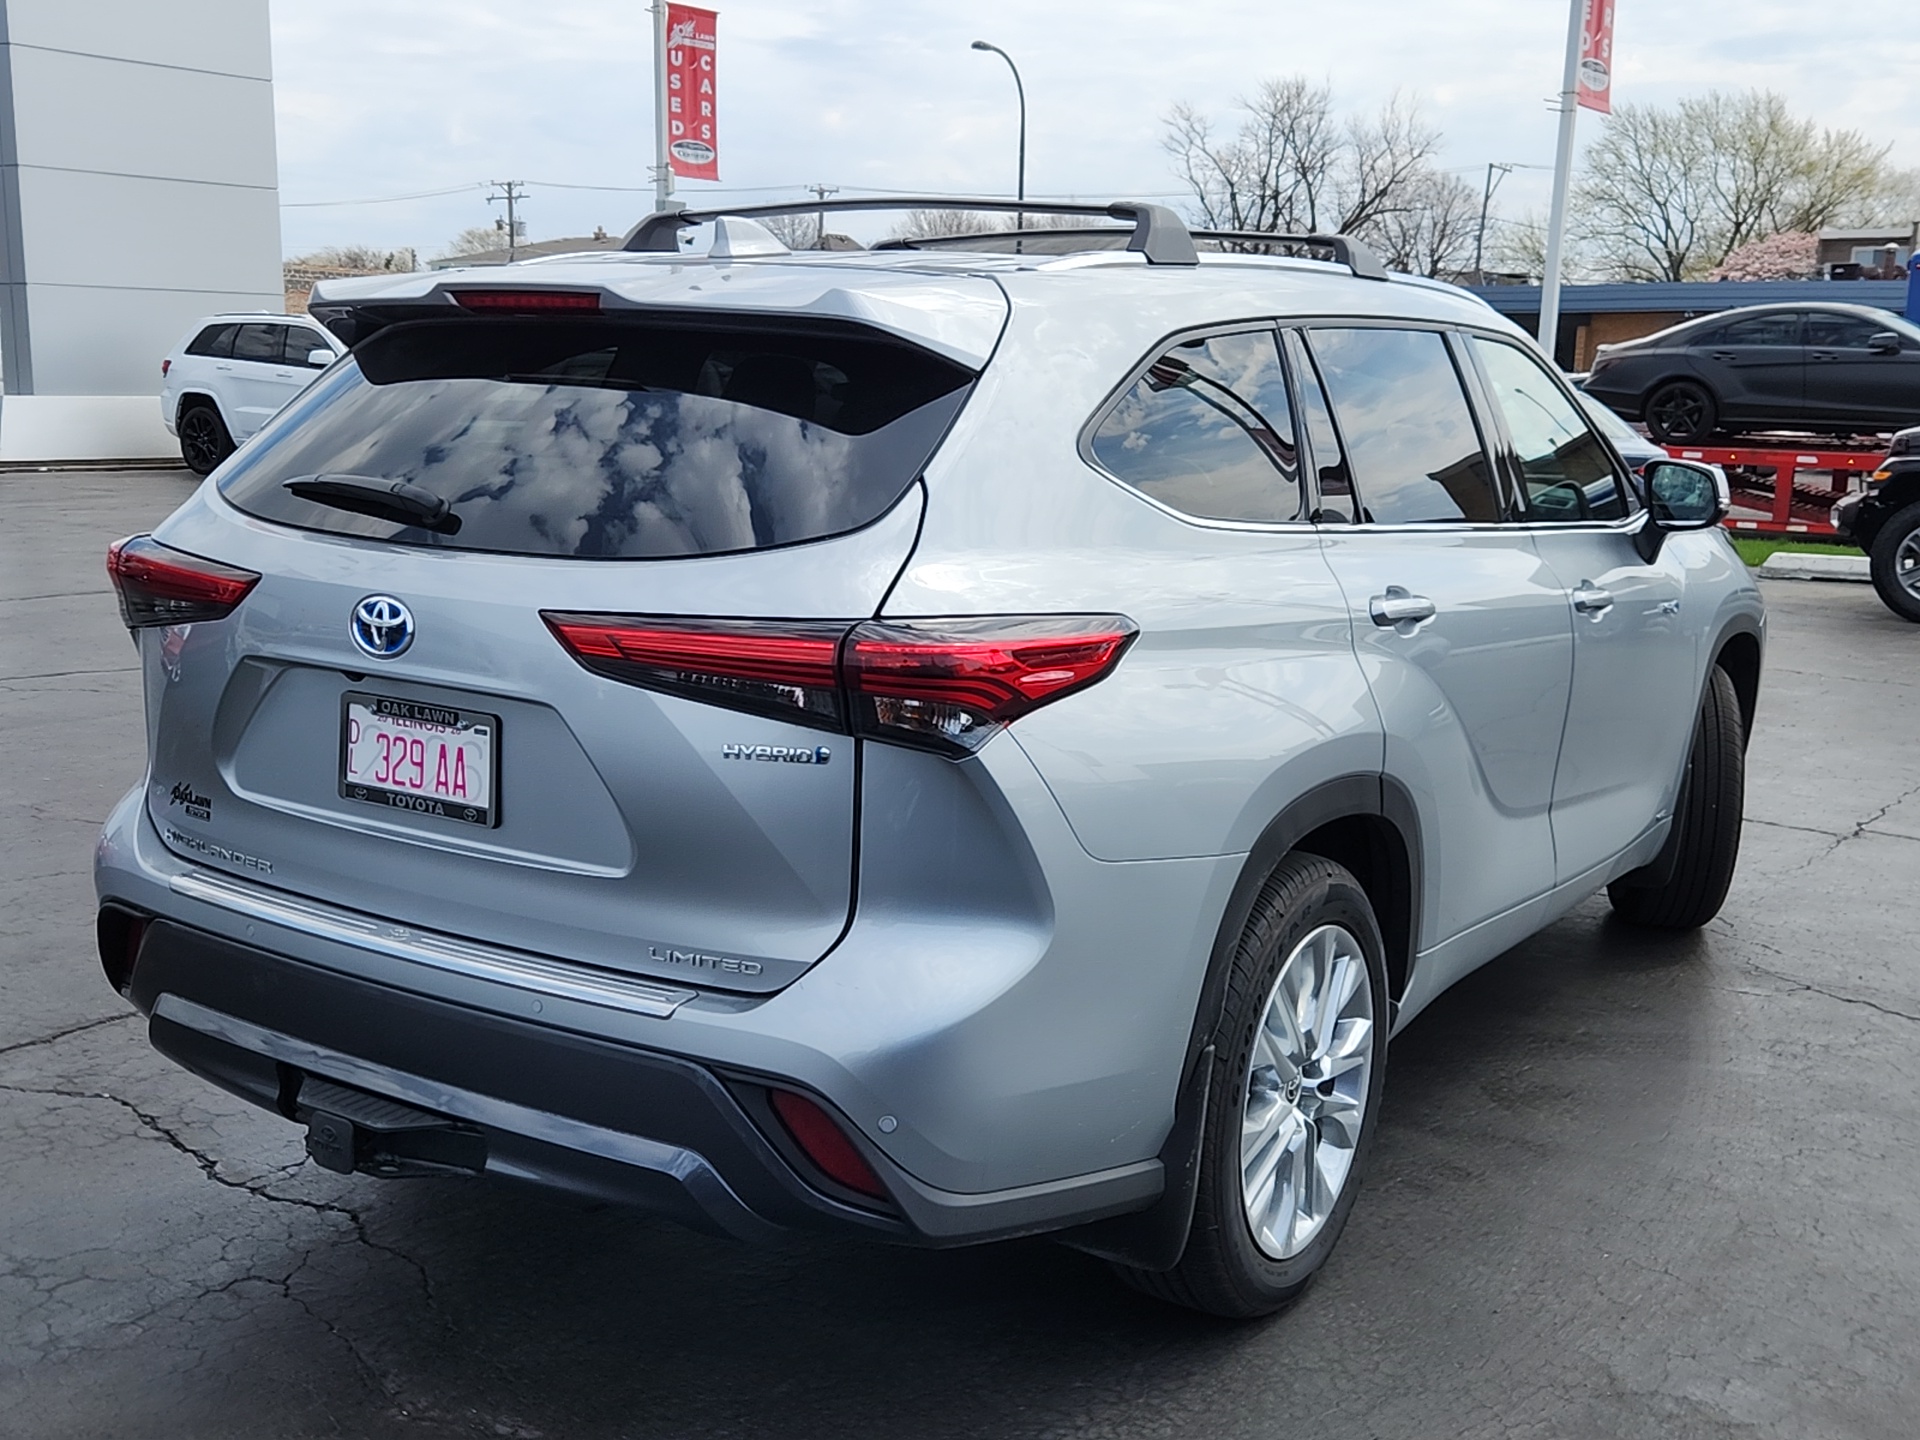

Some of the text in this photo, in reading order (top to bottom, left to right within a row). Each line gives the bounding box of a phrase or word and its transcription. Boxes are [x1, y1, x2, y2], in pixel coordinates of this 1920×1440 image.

[670, 50, 685, 136] USED
[700, 55, 713, 140] CARS
[381, 701, 455, 725] OAK LAWN
[375, 732, 467, 798] 329 AA
[722, 743, 813, 763] HYBRID
[386, 793, 445, 816] TOYOTA
[164, 828, 275, 875] HIGHLANDER
[648, 946, 763, 975] LIMITED
